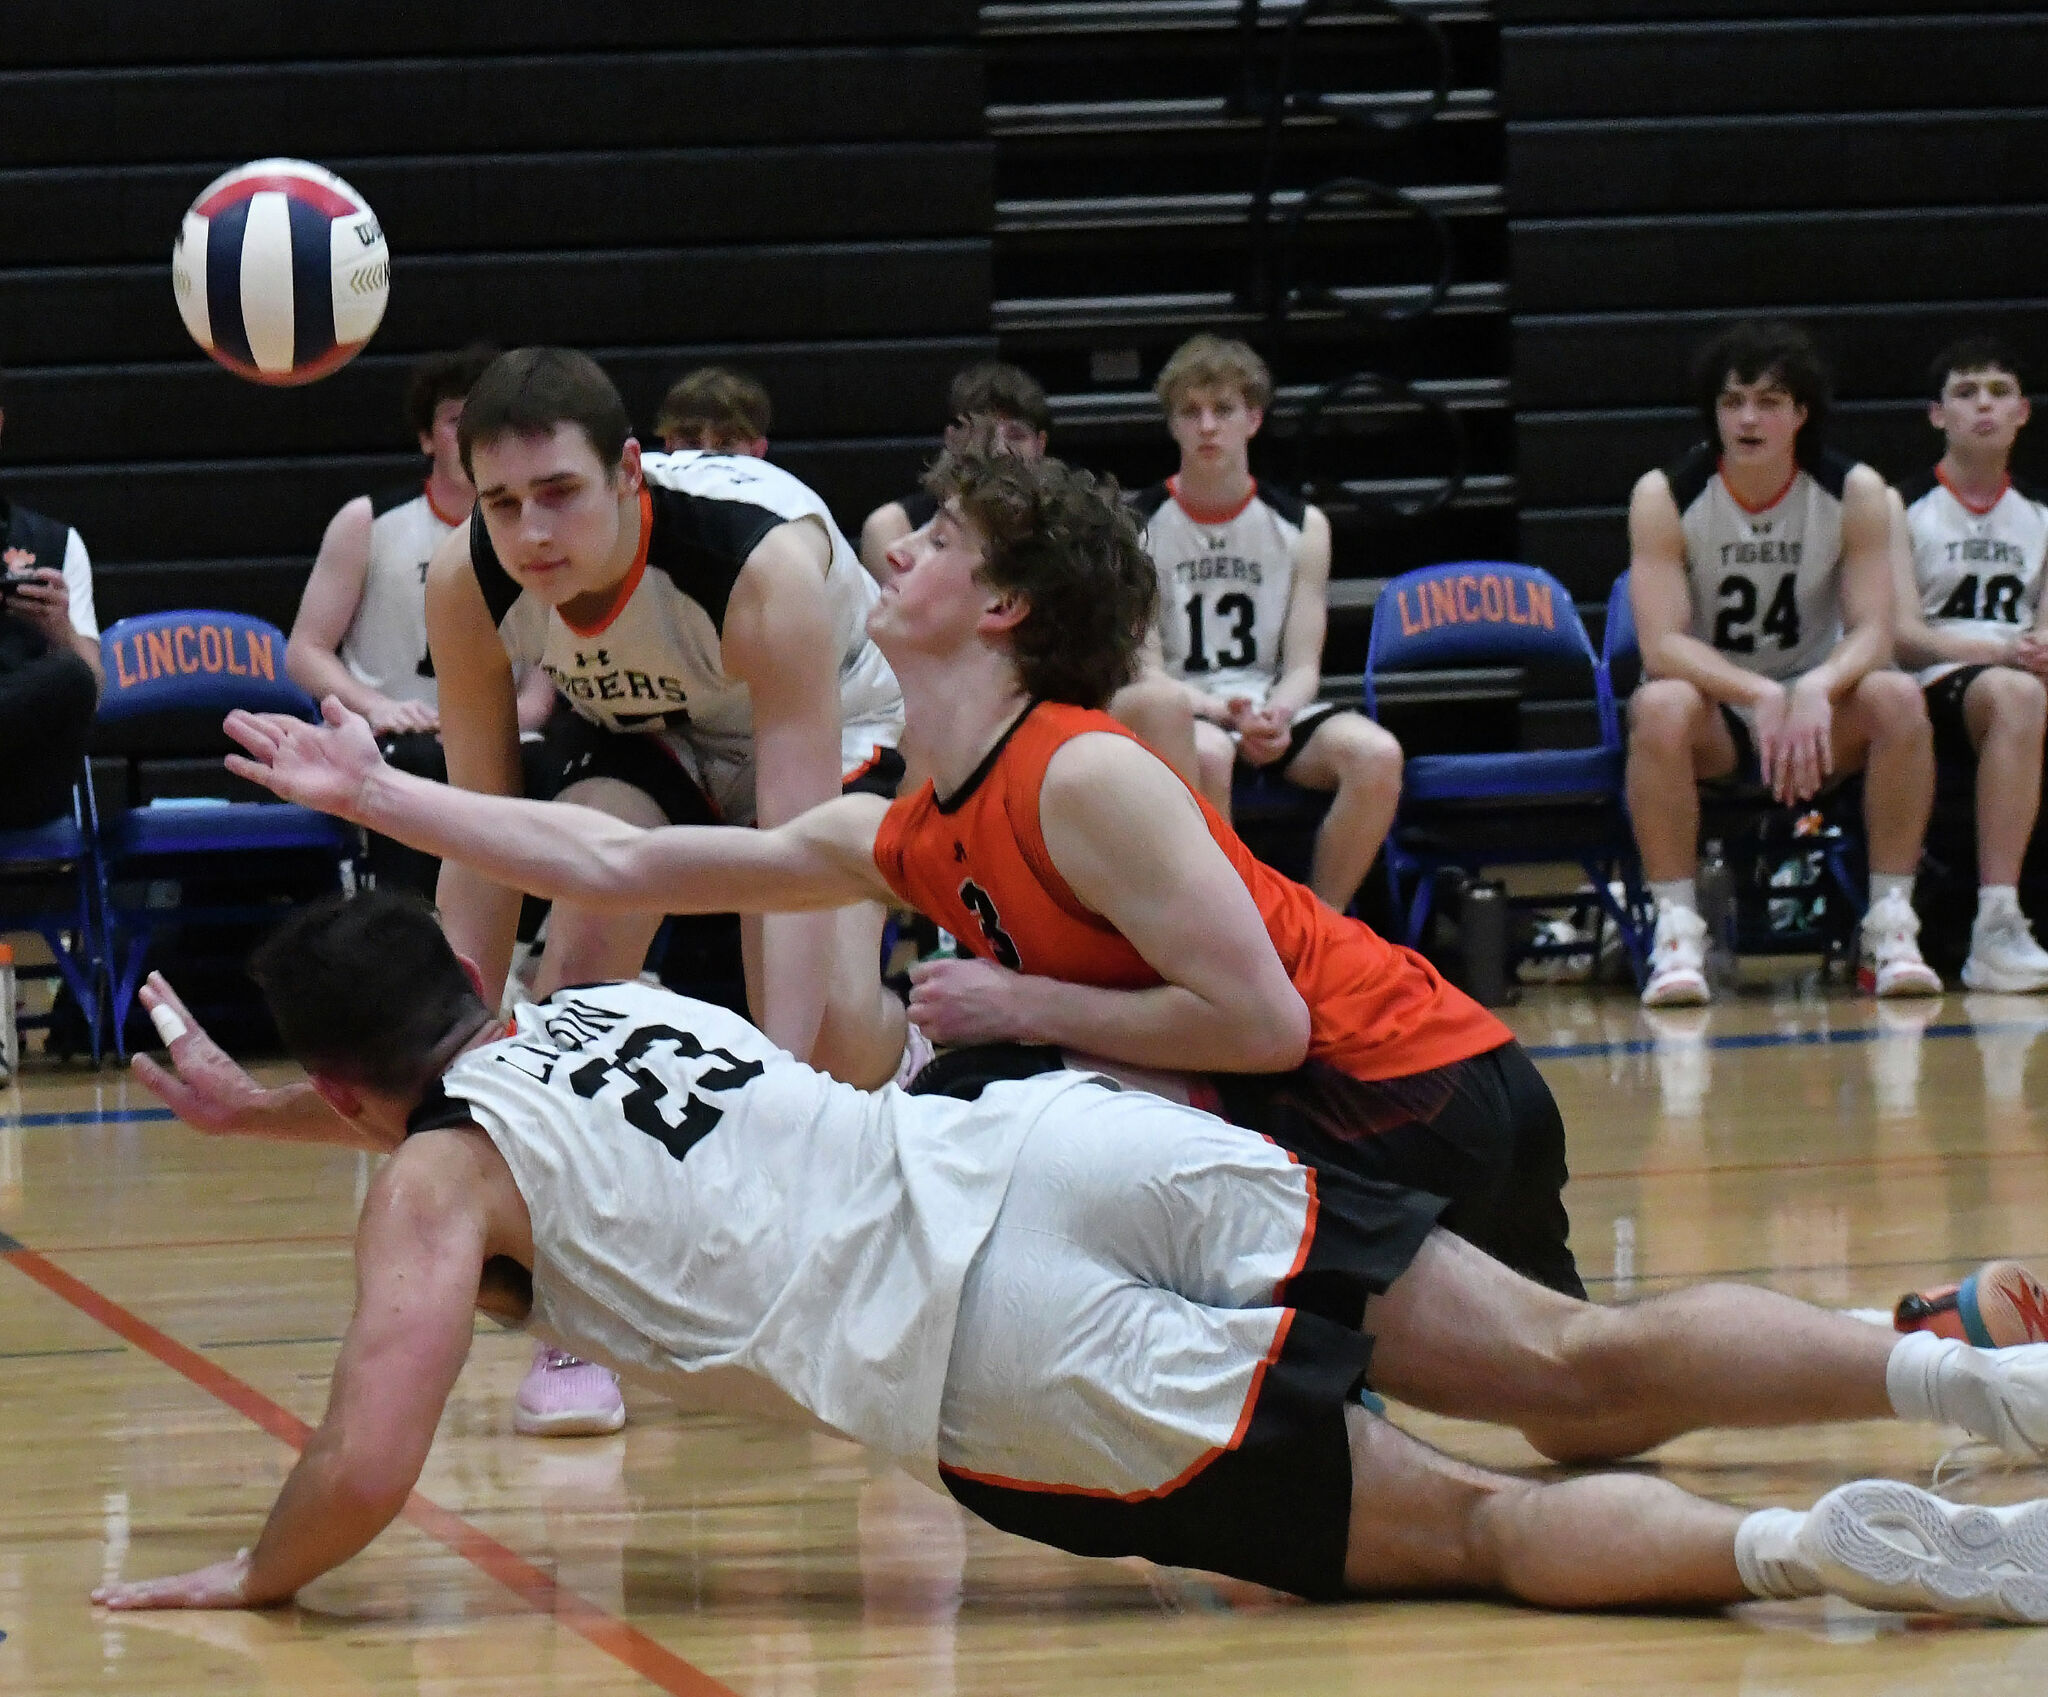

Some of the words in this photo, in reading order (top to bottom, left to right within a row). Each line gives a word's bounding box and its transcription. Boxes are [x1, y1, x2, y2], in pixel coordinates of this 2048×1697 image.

[1176, 556, 1262, 584] TIGERS
[1720, 541, 1803, 566] TIGERS
[1184, 592, 1256, 672] 13
[1398, 574, 1556, 637] LINCOLN
[1713, 571, 1800, 653] 24
[113, 625, 275, 688] LINCOLN
[958, 877, 1022, 971] 3
[569, 1024, 764, 1162] 23
